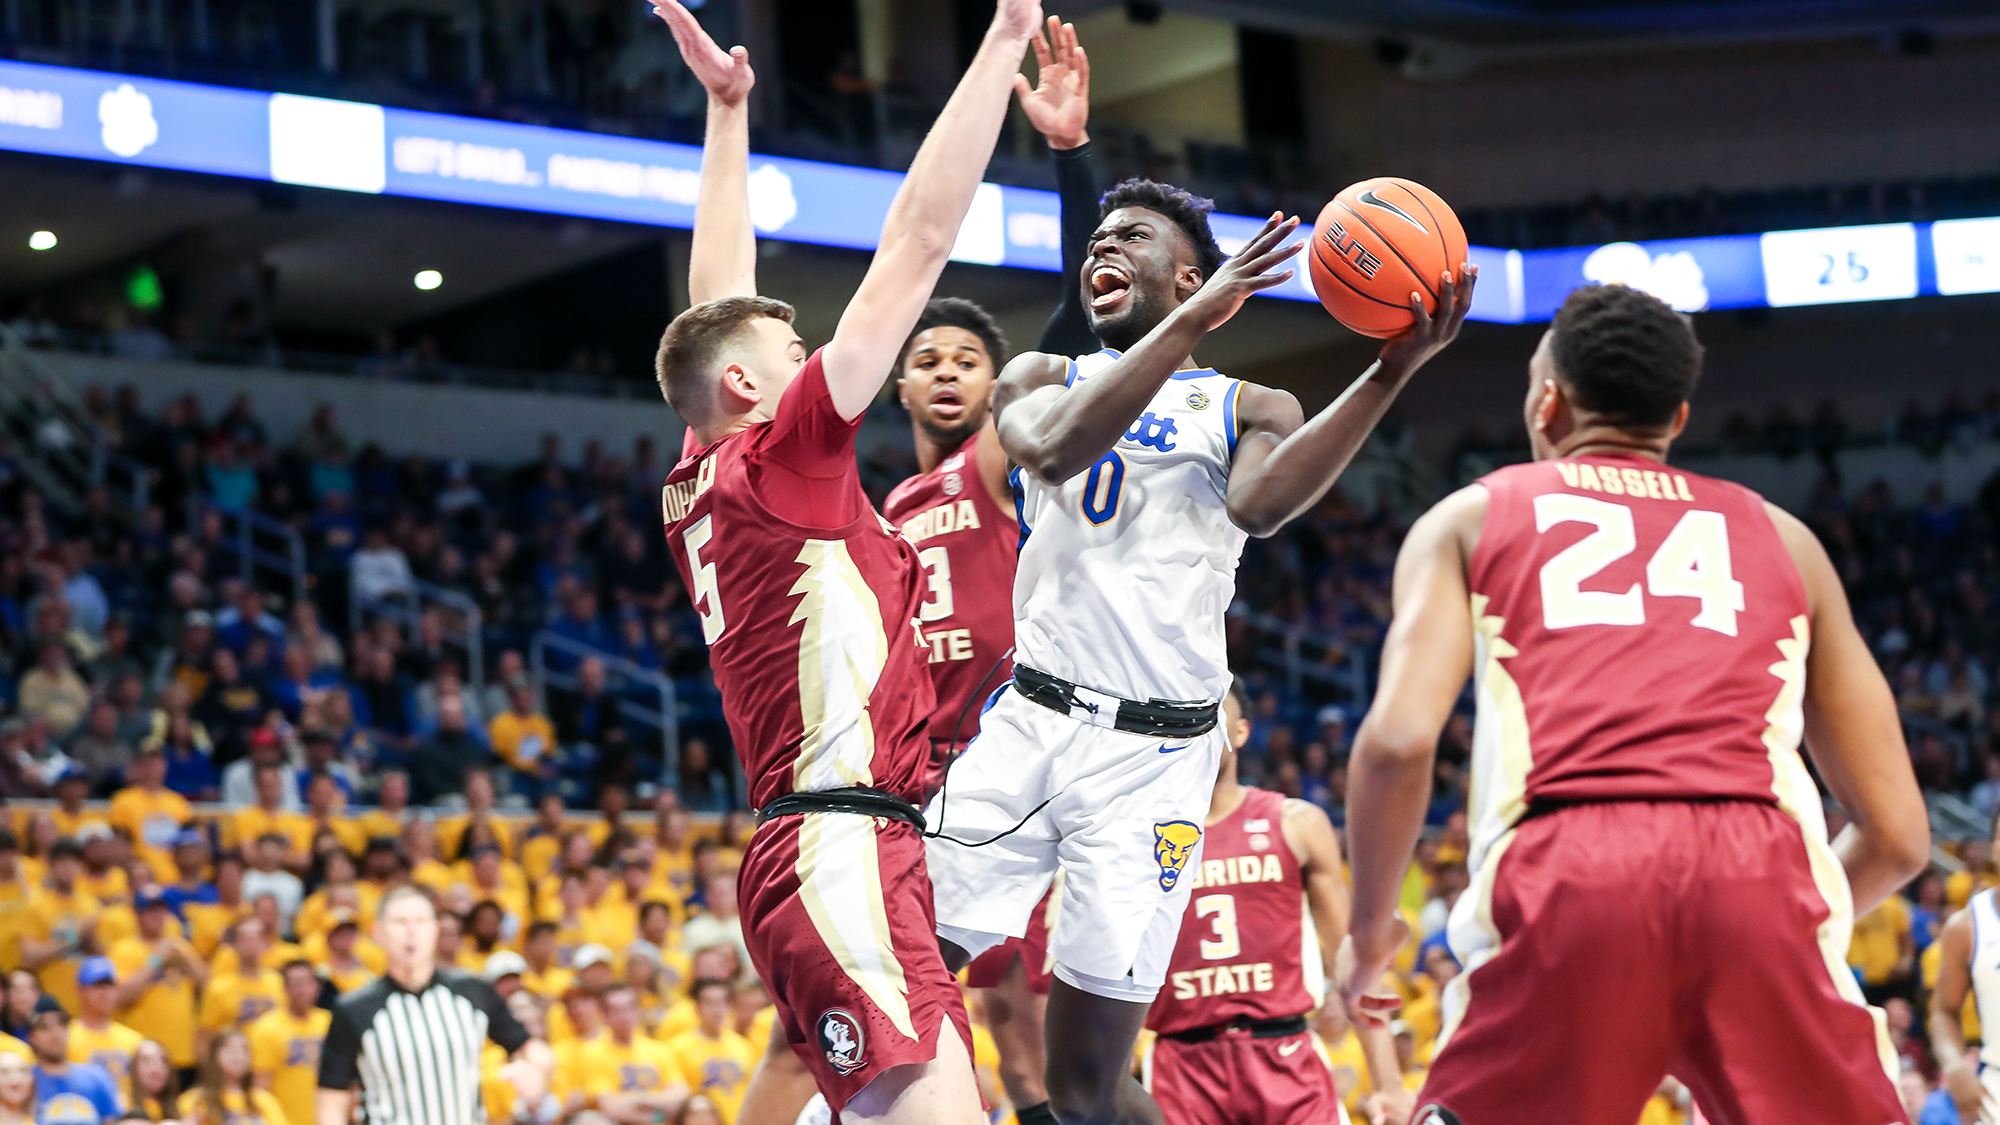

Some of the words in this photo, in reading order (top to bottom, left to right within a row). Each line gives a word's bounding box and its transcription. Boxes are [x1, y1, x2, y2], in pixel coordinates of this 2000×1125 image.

[1323, 219, 1384, 278] ELITE
[1081, 447, 1127, 527] 0
[1555, 462, 1695, 502] VASSELL
[682, 513, 726, 645] 5
[918, 547, 954, 622] 3
[1533, 493, 1745, 637] 24
[1195, 894, 1241, 960] 3
[1171, 962, 1273, 1000] STATE
